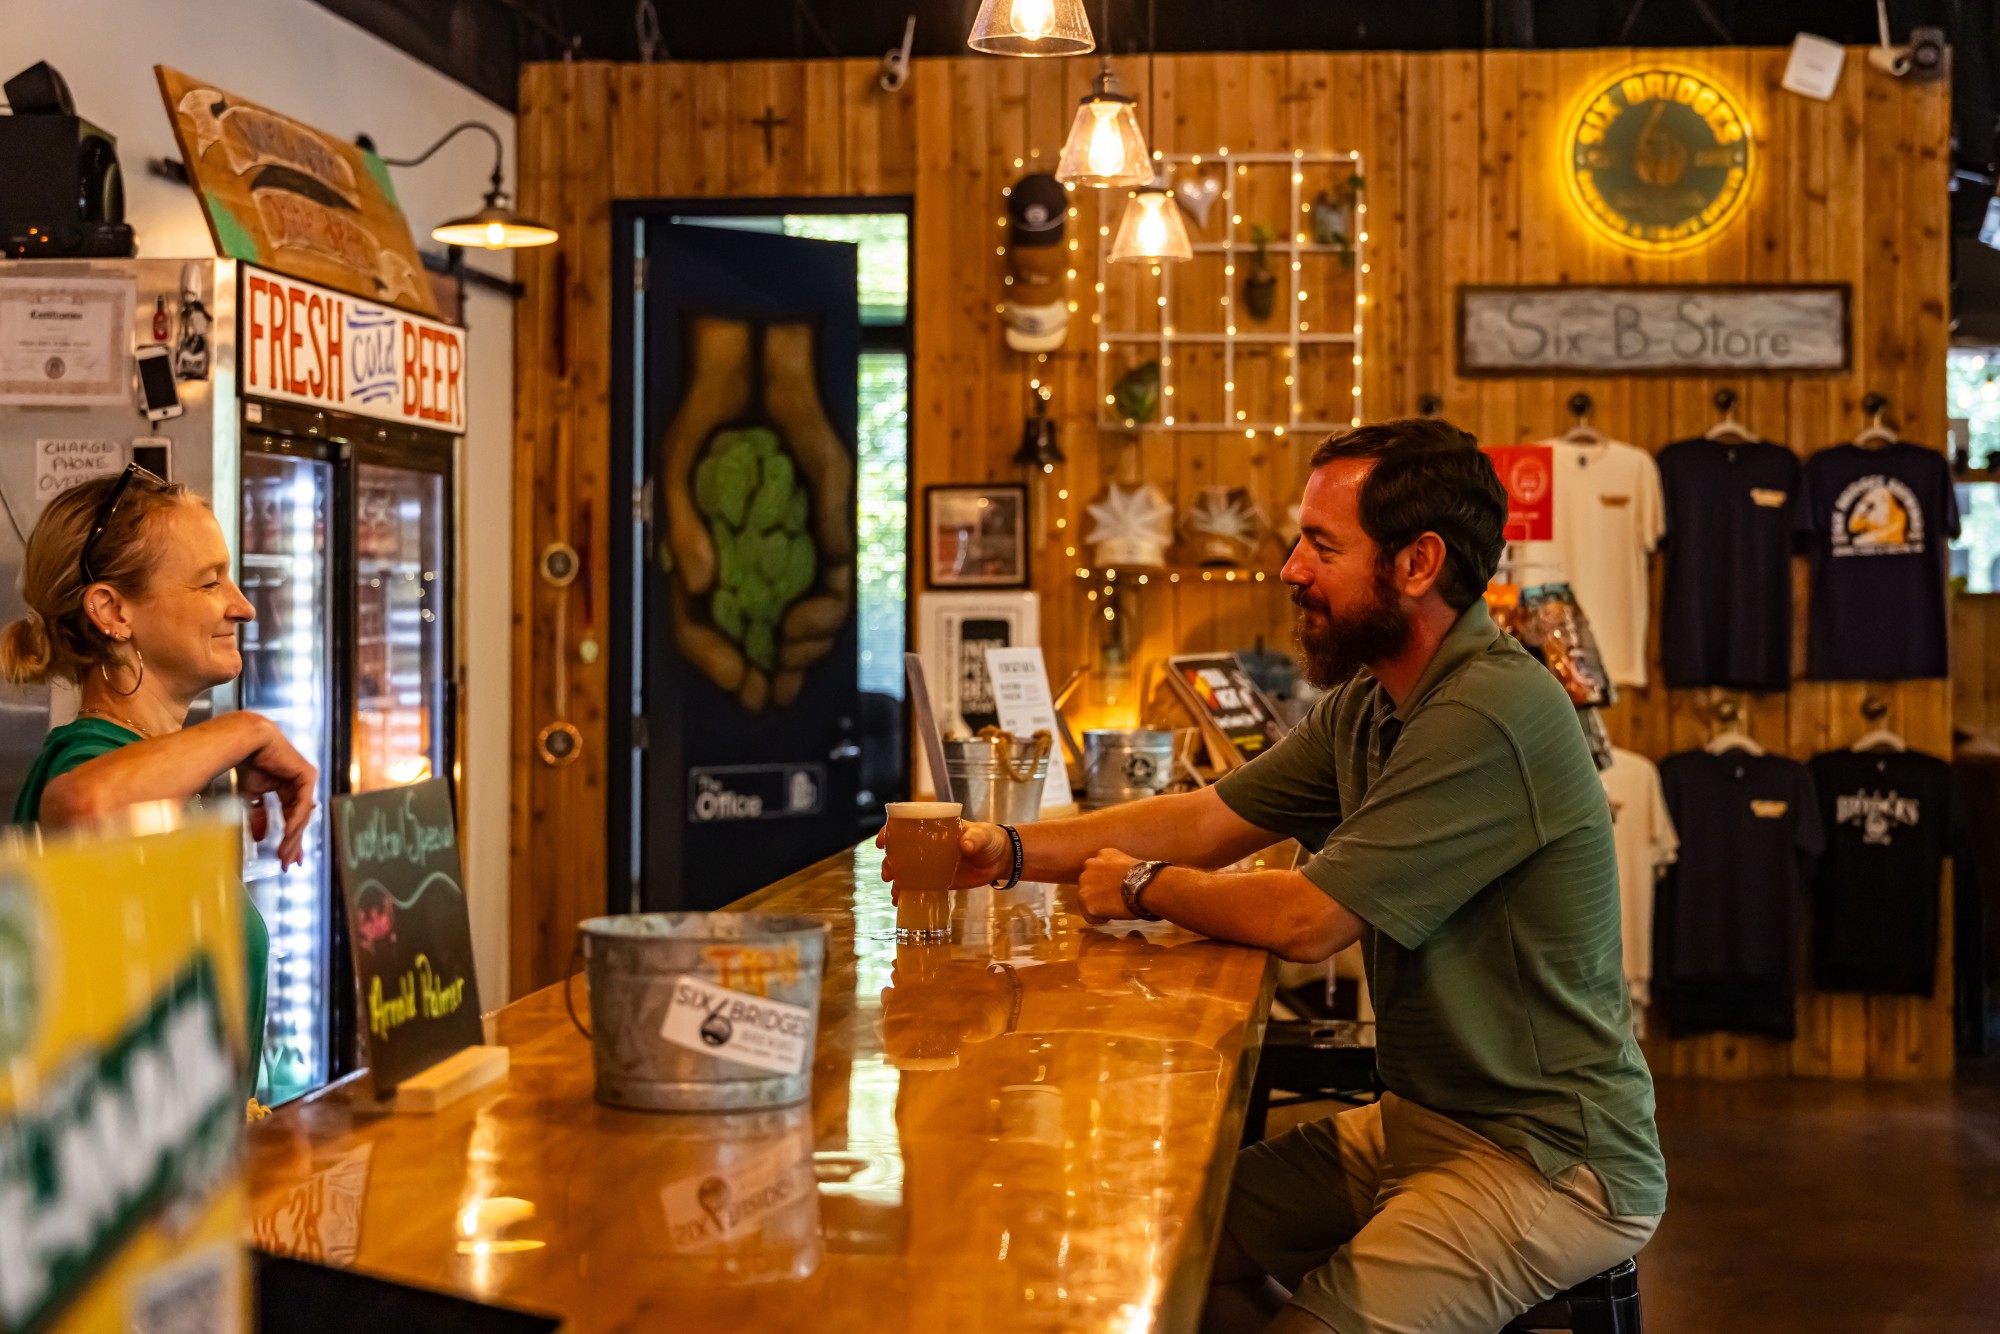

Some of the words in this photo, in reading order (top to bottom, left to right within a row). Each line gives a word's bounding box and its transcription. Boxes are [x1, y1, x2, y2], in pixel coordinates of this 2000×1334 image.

[1577, 94, 1621, 145] SIX
[1621, 73, 1743, 145] BRIDGES
[250, 276, 344, 403] FRESH
[403, 320, 462, 427] BEER
[1506, 297, 1586, 360] Six
[1613, 302, 1650, 360] B
[1670, 297, 1793, 361] Store
[52, 456, 108, 472] PHONE
[696, 790, 763, 820] Office
[699, 775, 723, 792] The
[369, 969, 417, 1041] Arnold
[415, 953, 465, 1019] Palmer
[676, 984, 716, 1015] SIX
[730, 1000, 809, 1038] BRIDGES
